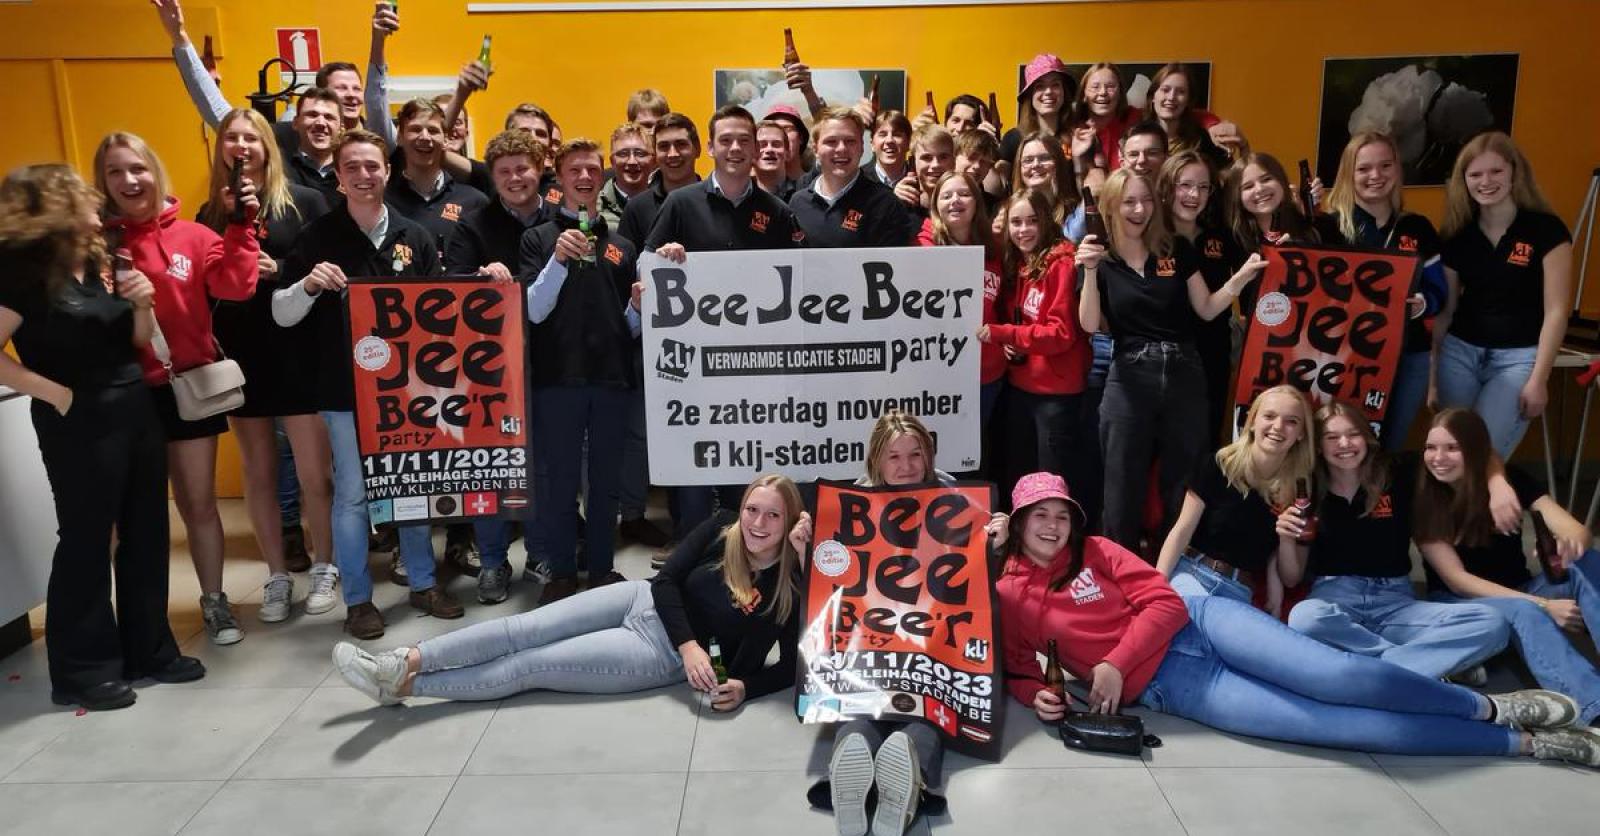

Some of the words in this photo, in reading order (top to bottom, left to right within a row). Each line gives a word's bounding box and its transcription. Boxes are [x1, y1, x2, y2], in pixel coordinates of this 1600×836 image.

[651, 267, 749, 328] Bee
[757, 265, 850, 325] Jee
[1278, 251, 1395, 307] Bee
[370, 288, 505, 338] Bee
[1267, 301, 1388, 360] Jee
[376, 340, 505, 391] Jee
[707, 350, 784, 370] VERWARMDE
[787, 349, 834, 368] LOCATIE
[838, 347, 881, 366] STADEN
[890, 332, 969, 374] party
[667, 400, 700, 427] 2e
[709, 397, 828, 428] zaterdag
[837, 390, 962, 421] november
[364, 448, 527, 476] 11/11/2023
[380, 431, 436, 451] party
[729, 438, 864, 473] klj-staden
[365, 475, 398, 488] TENT
[402, 468, 527, 485] SLEIHAGE-STADEN
[833, 492, 973, 549] Bee
[832, 551, 969, 605] Jee
